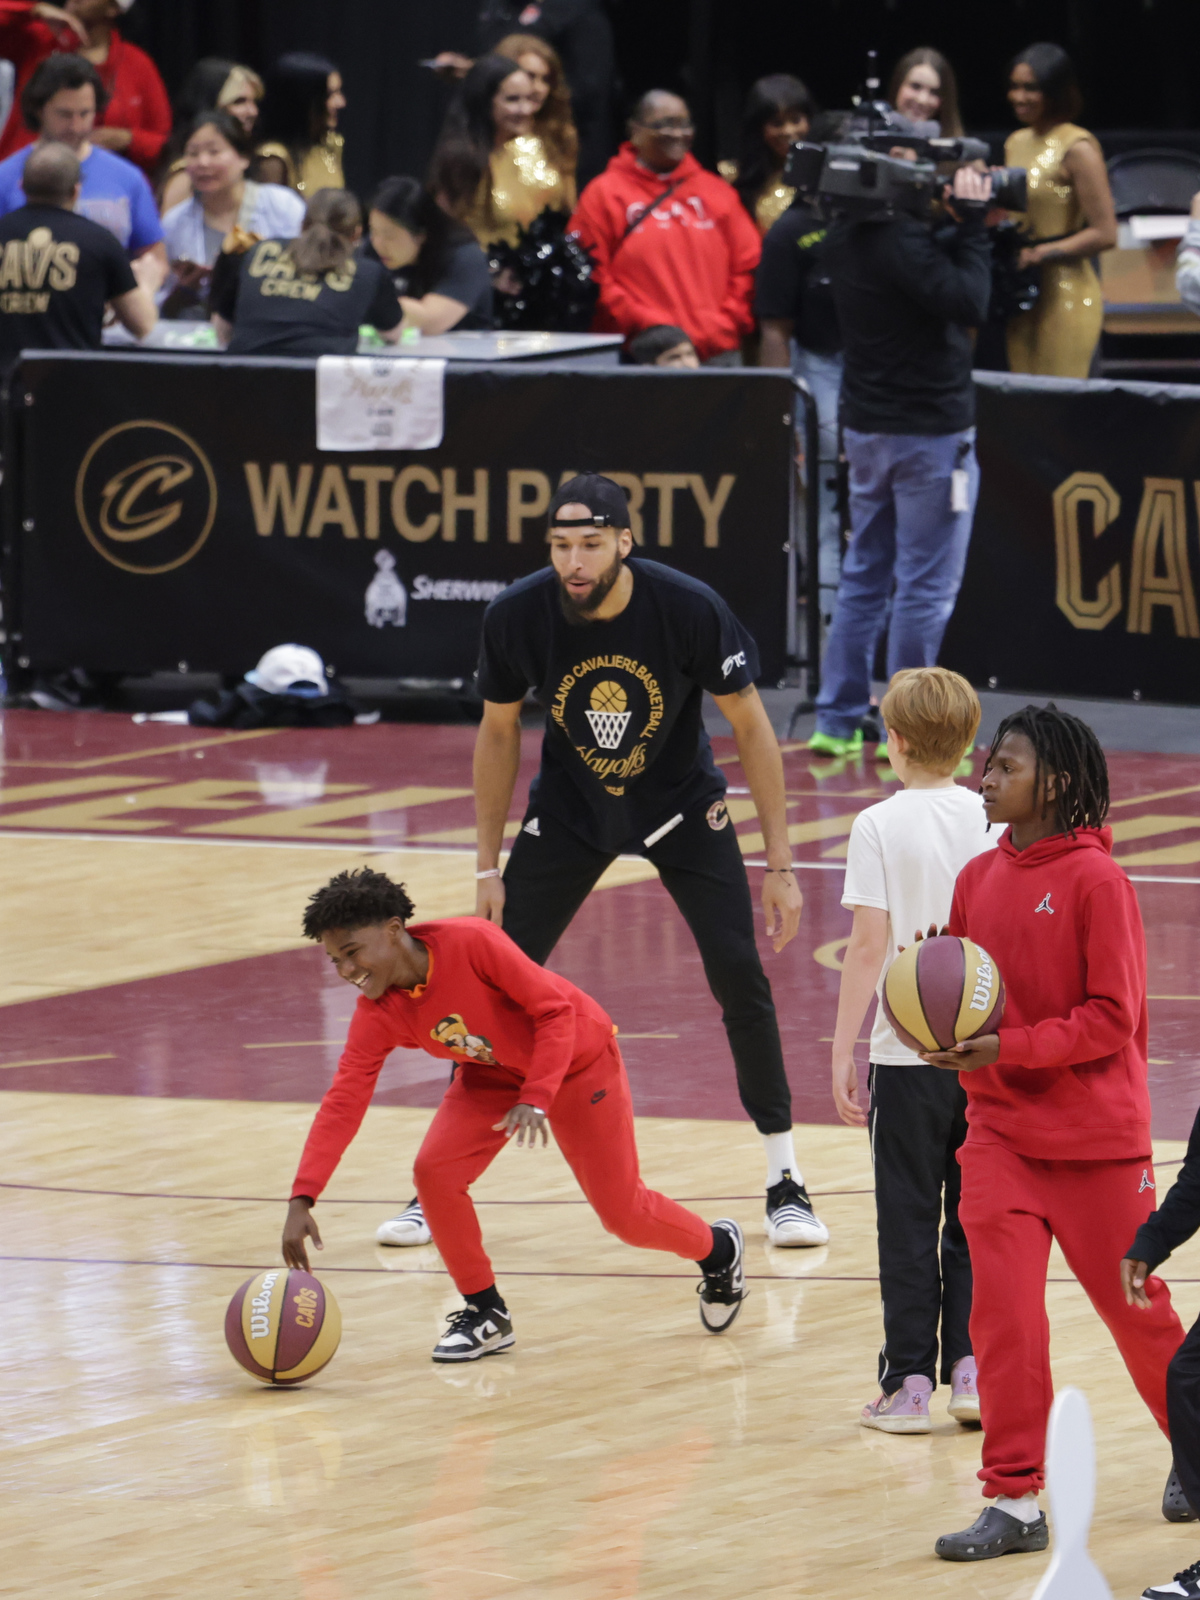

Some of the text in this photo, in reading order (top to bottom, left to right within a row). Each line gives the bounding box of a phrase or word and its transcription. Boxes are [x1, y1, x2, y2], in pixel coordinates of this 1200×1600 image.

[0, 236, 81, 292] AVS
[247, 240, 358, 293] CAS
[244, 461, 738, 548] WATCH PRTY
[572, 654, 638, 679] CAVALIERS
[634, 664, 665, 739] BASKETBALL
[250, 1271, 281, 1341] Wilson
[294, 1287, 319, 1329] CAVS
